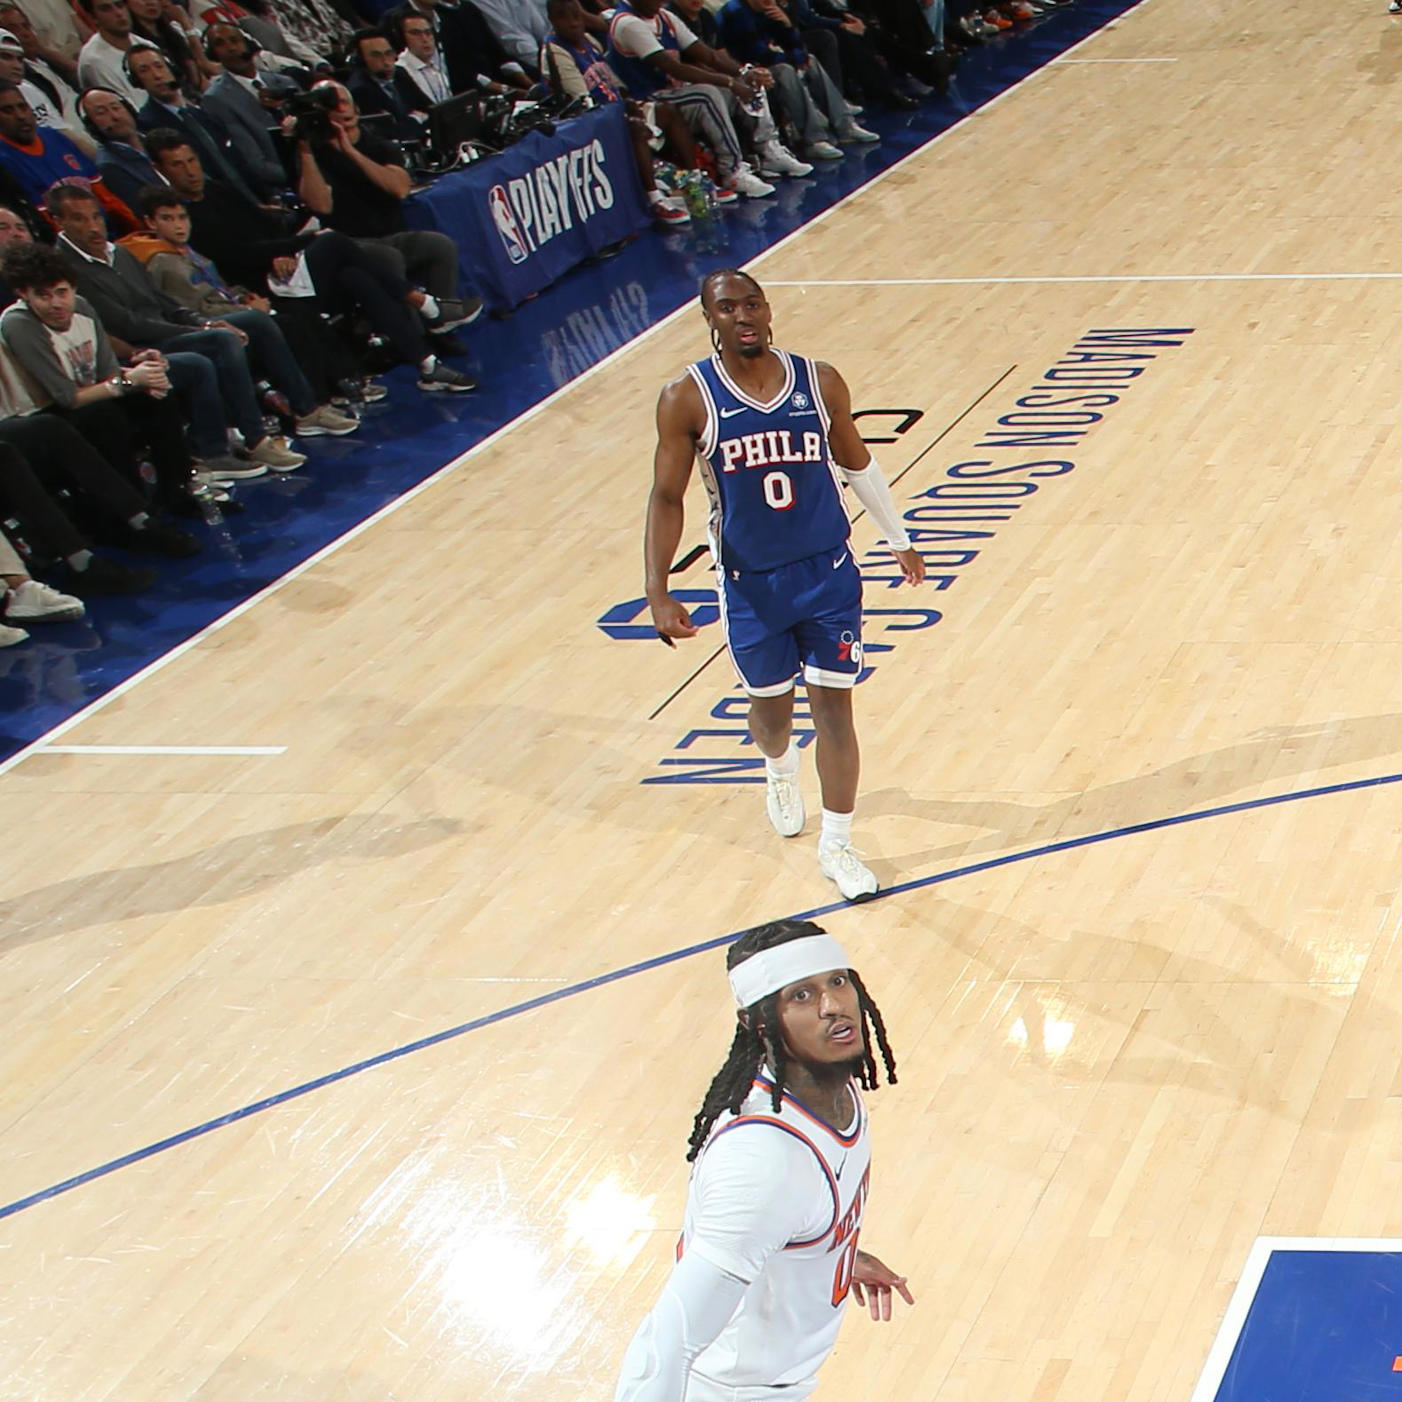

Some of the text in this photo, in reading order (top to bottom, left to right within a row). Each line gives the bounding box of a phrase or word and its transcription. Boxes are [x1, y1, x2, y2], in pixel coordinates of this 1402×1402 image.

[974, 328, 1196, 447] MADISON
[719, 430, 823, 473] PHILA
[763, 471, 797, 511] 0
